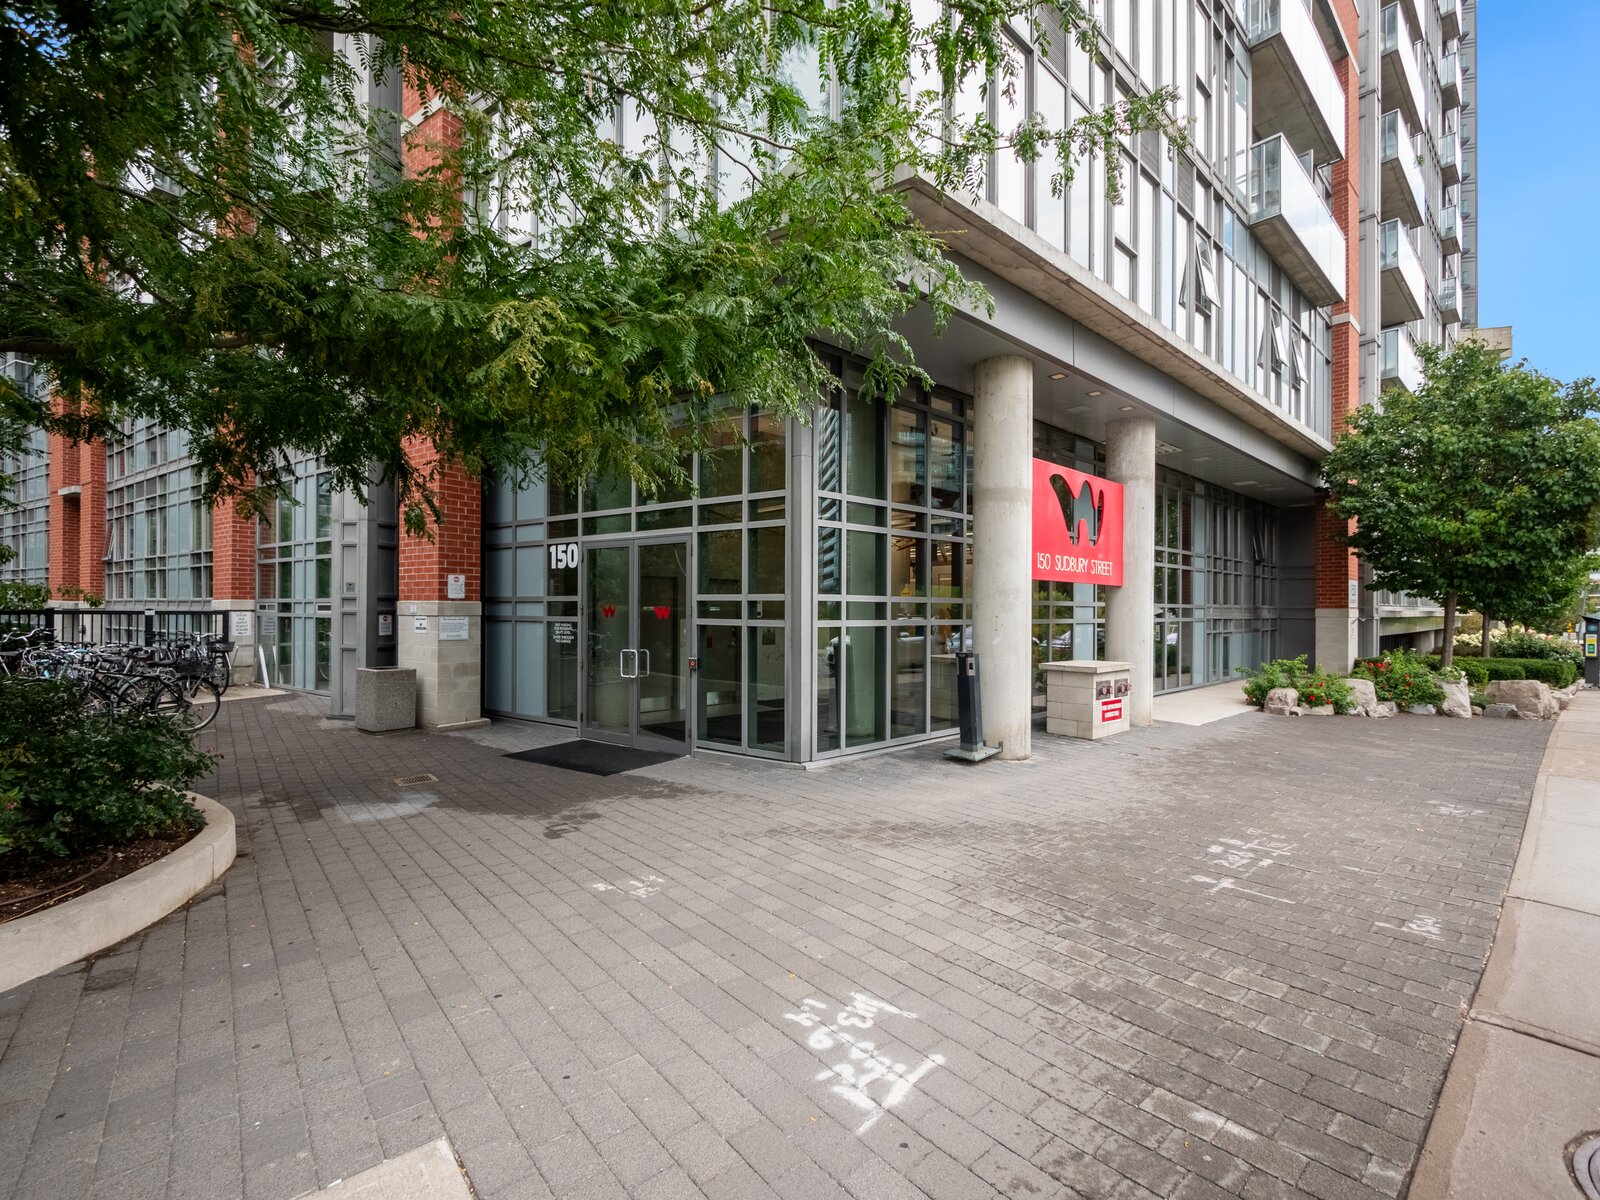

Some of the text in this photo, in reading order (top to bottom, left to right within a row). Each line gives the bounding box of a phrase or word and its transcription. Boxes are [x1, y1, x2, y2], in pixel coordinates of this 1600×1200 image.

[550, 543, 578, 569] 150
[1037, 552, 1113, 576] 150 SUDBURY STREET
